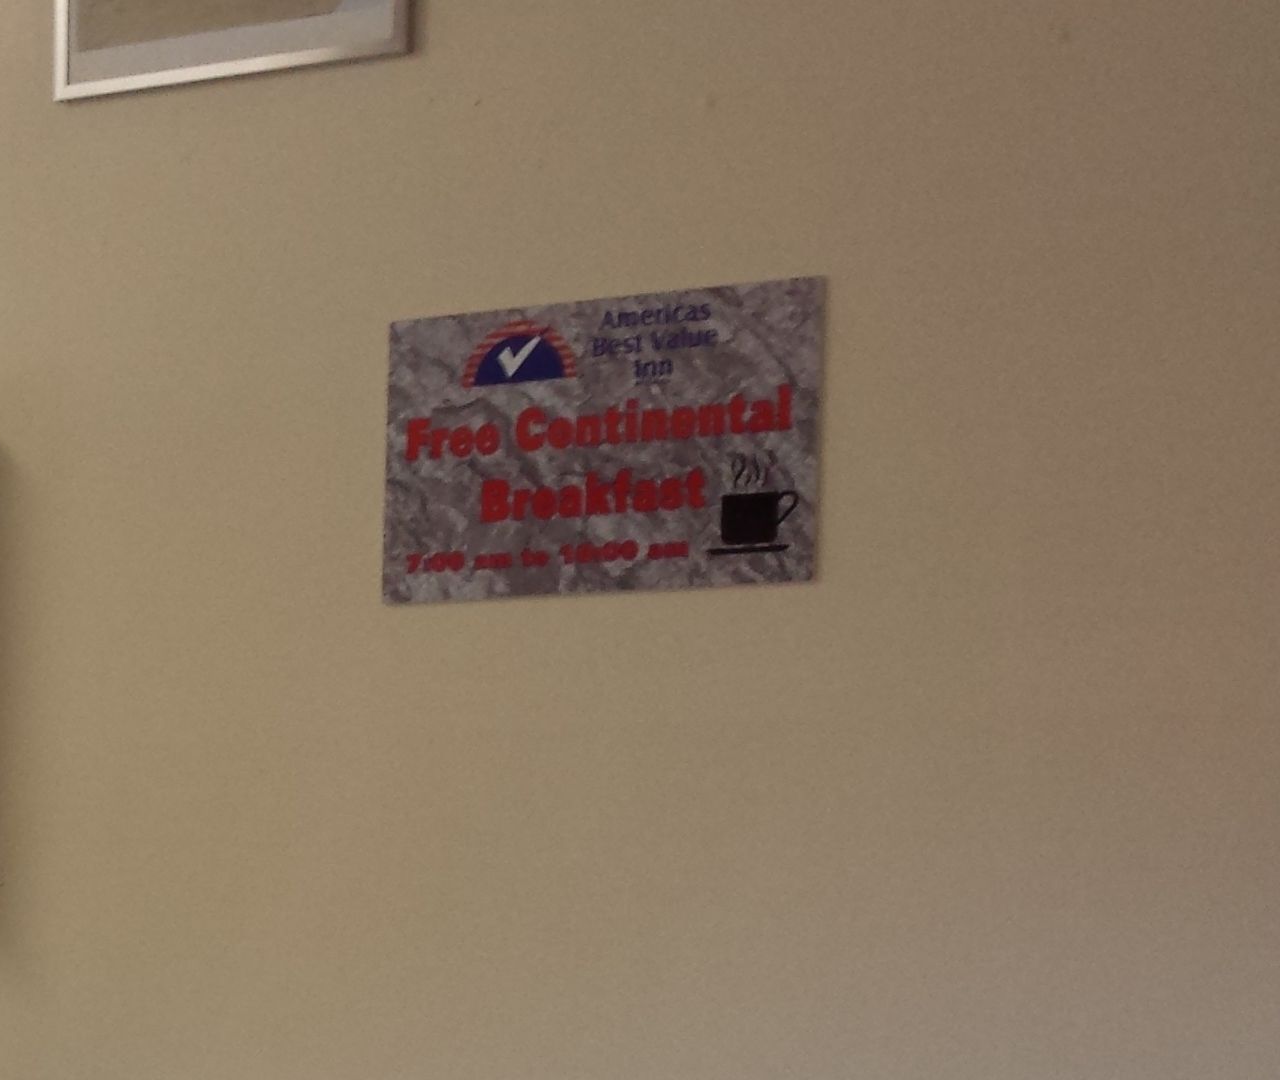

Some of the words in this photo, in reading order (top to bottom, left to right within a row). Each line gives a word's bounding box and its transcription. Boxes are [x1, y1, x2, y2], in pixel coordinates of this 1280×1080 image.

[598, 303, 711, 331] Americas
[592, 335, 642, 358] Best
[651, 328, 719, 351] Value
[404, 416, 500, 462] Free
[515, 382, 792, 453] Continental
[480, 466, 706, 523] Breakfast
[520, 548, 550, 568] to
